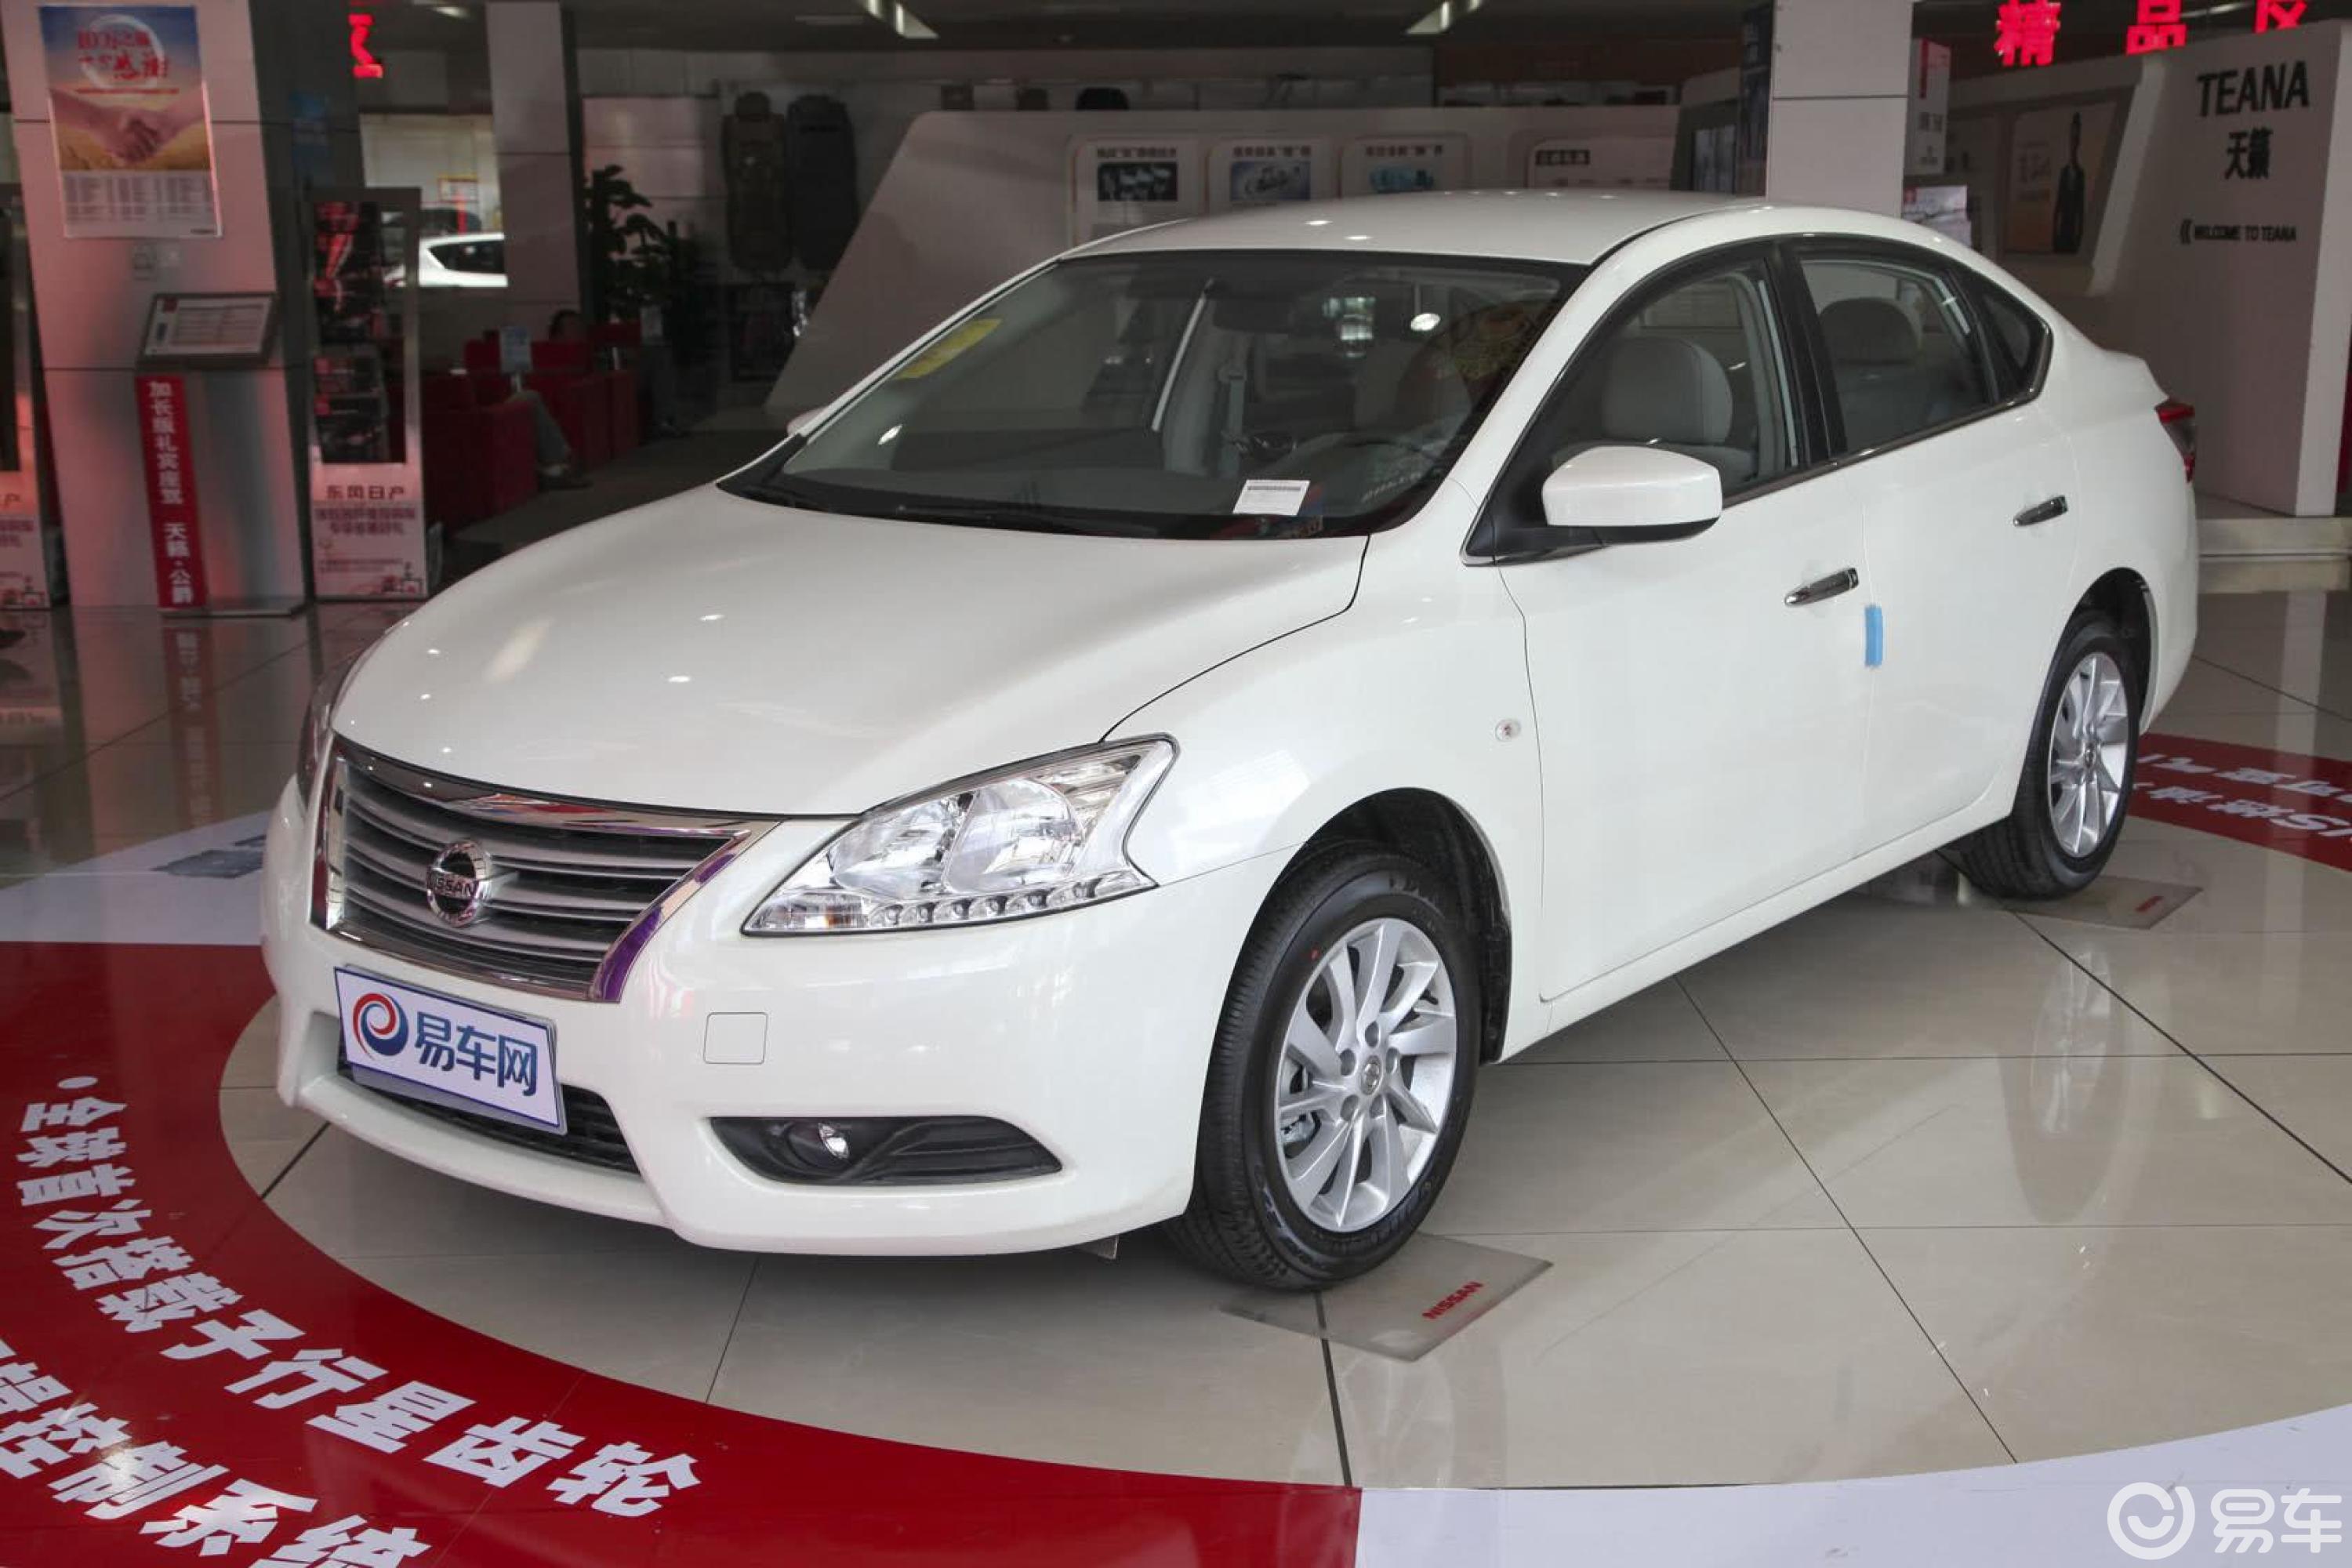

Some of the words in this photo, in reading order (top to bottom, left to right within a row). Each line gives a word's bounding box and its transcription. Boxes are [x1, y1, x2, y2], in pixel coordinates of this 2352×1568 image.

[2197, 60, 2309, 118] TEANA
[2195, 224, 2241, 241] WELCOME
[2245, 225, 2259, 241] TO
[2262, 224, 2297, 241] TEANA
[326, 485, 405, 500] 东风日产
[415, 1011, 538, 1097] 易车网
[1421, 1282, 1483, 1319] NISSAN
